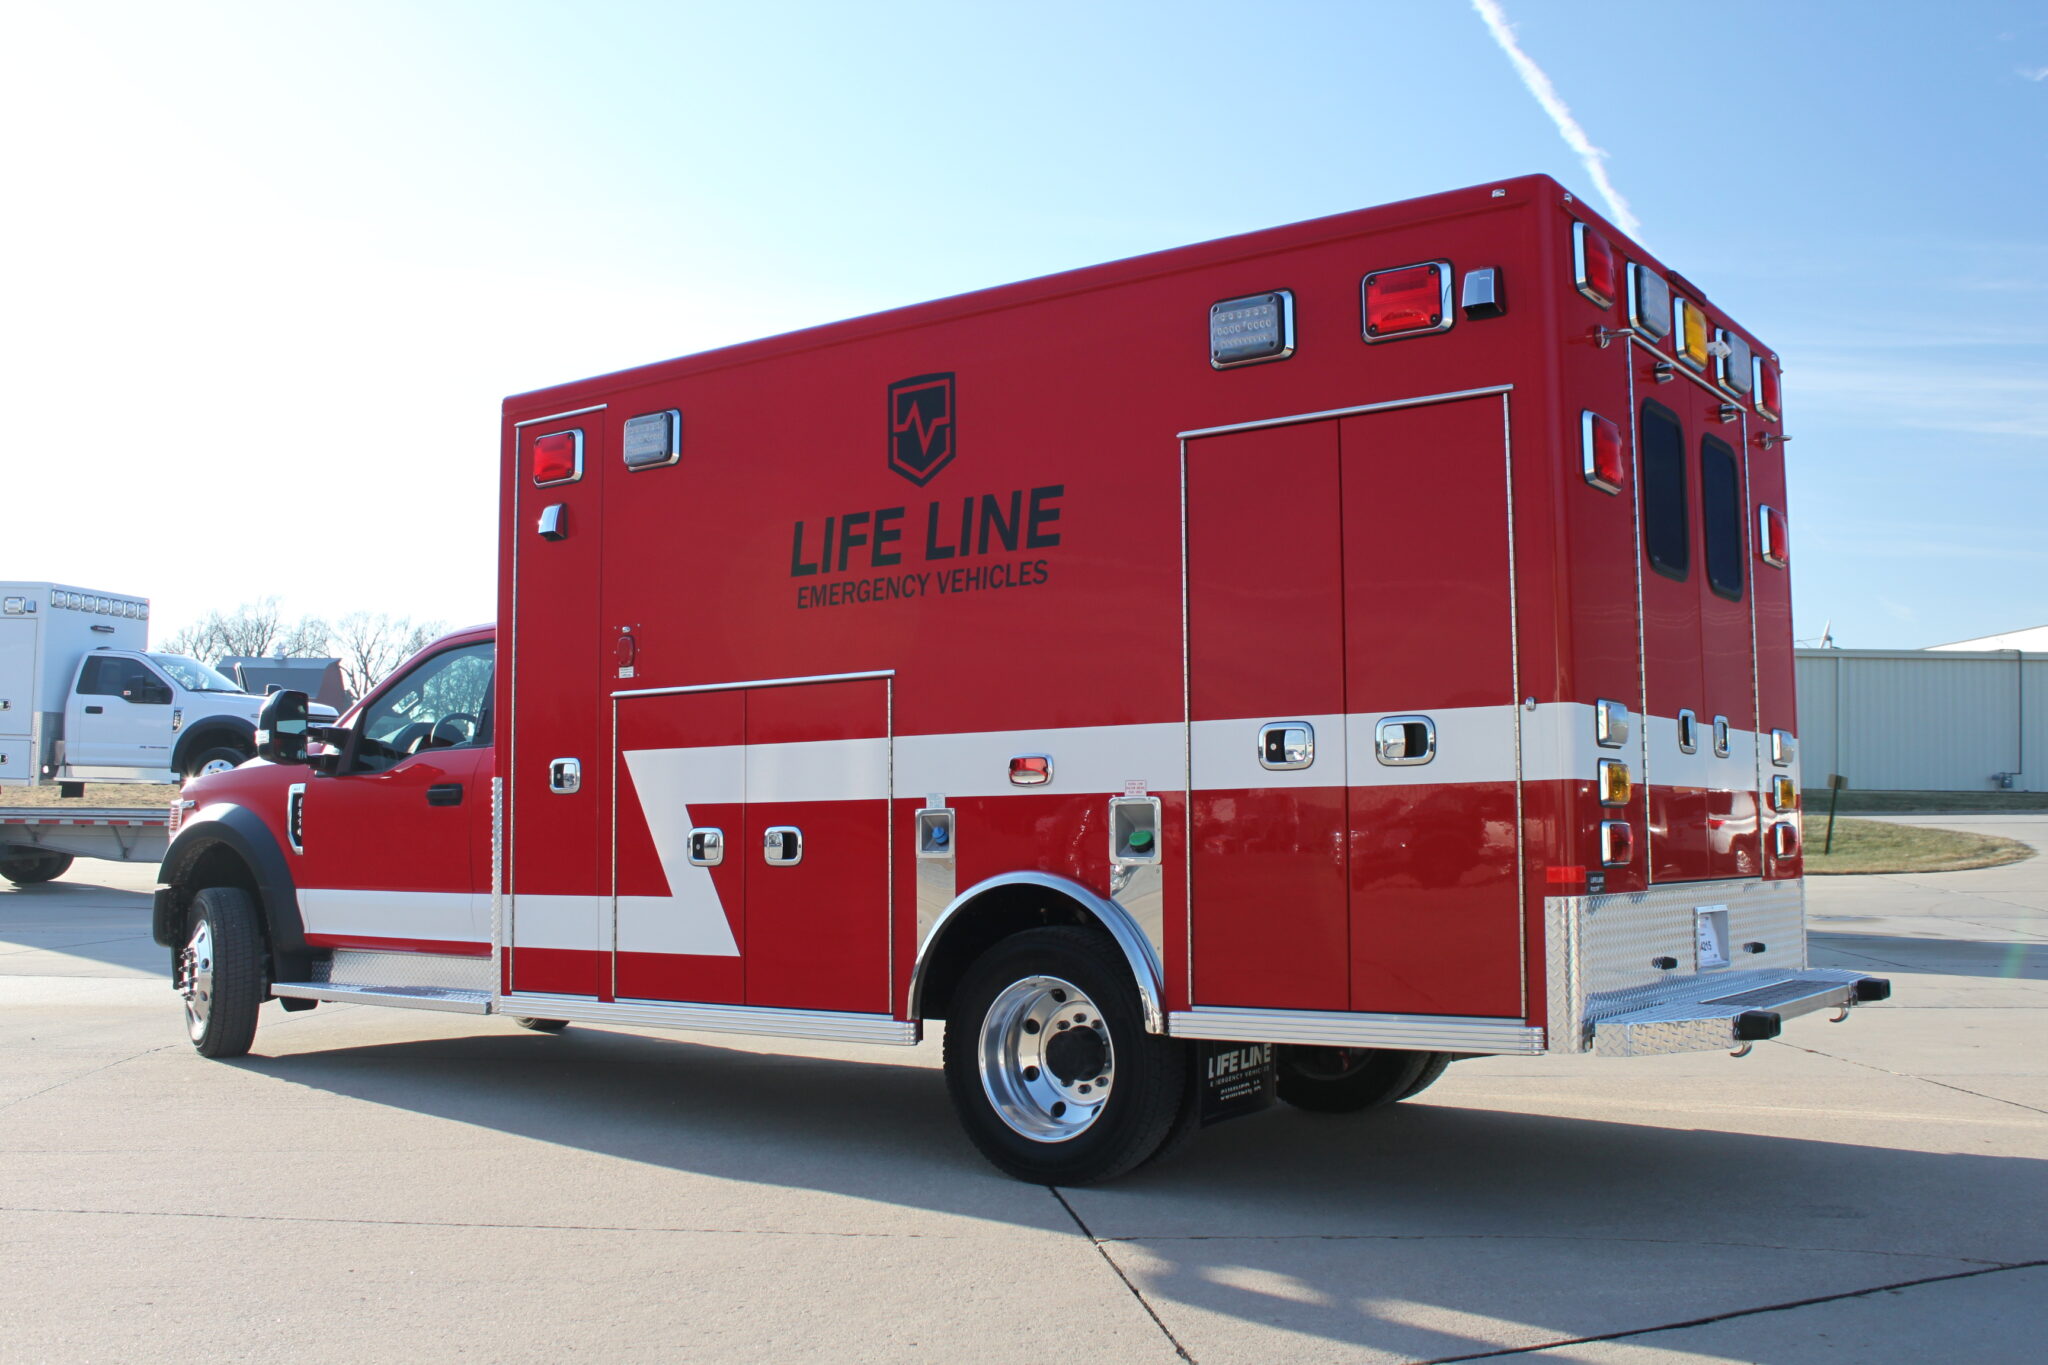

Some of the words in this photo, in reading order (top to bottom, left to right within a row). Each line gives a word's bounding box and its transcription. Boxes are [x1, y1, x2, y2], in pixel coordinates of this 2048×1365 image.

[790, 506, 905, 577] LIFE
[925, 484, 1064, 561] LINE
[797, 573, 930, 609] EMERGENCY
[937, 559, 1049, 594] VEHICLES
[1208, 1050, 1239, 1079] LIFE
[1241, 1043, 1272, 1070] LINE
[1210, 1073, 1243, 1087] EERGENCY
